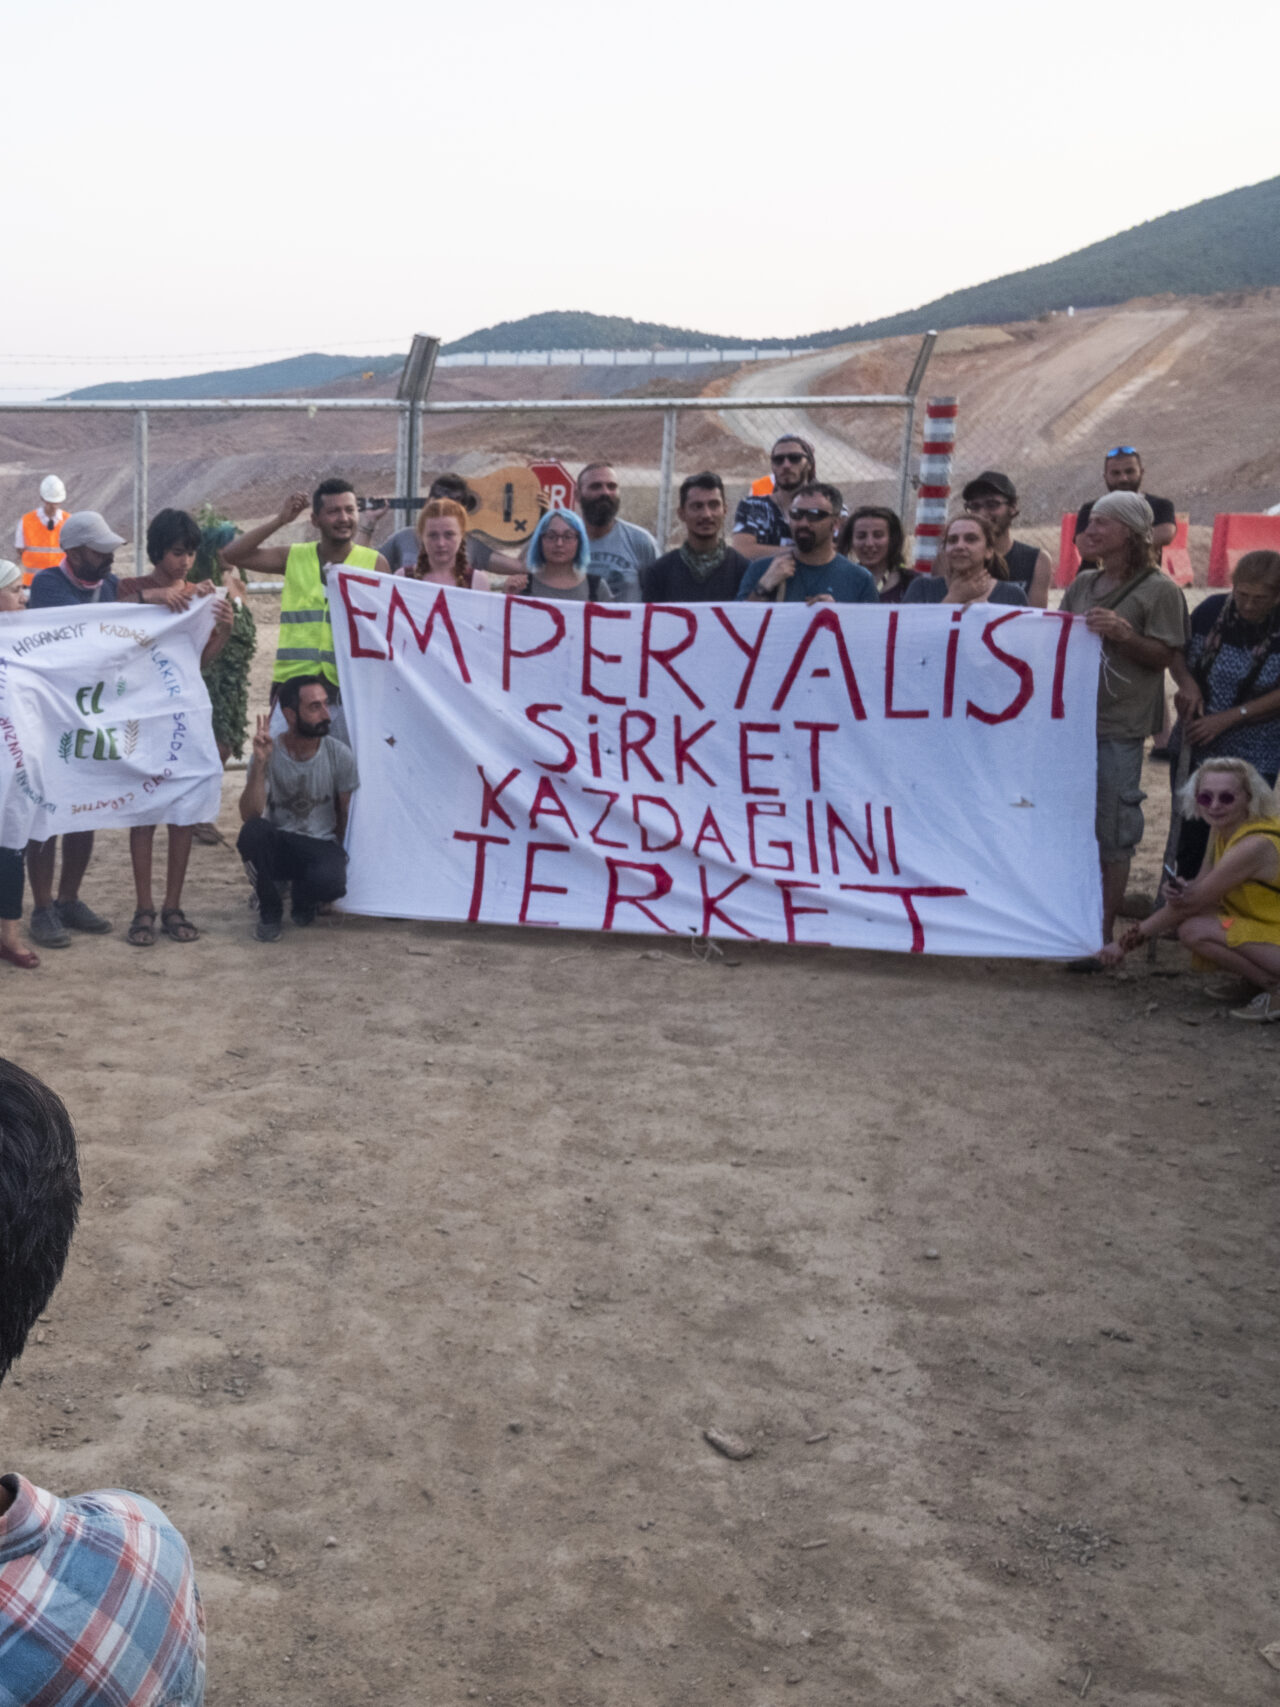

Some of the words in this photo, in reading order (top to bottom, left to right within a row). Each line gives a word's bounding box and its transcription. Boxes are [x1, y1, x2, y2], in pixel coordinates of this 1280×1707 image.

[12, 622, 87, 657] HASANKEYF
[75, 681, 104, 716] EL
[166, 712, 187, 762] SALDA
[453, 831, 967, 953] TERKET
